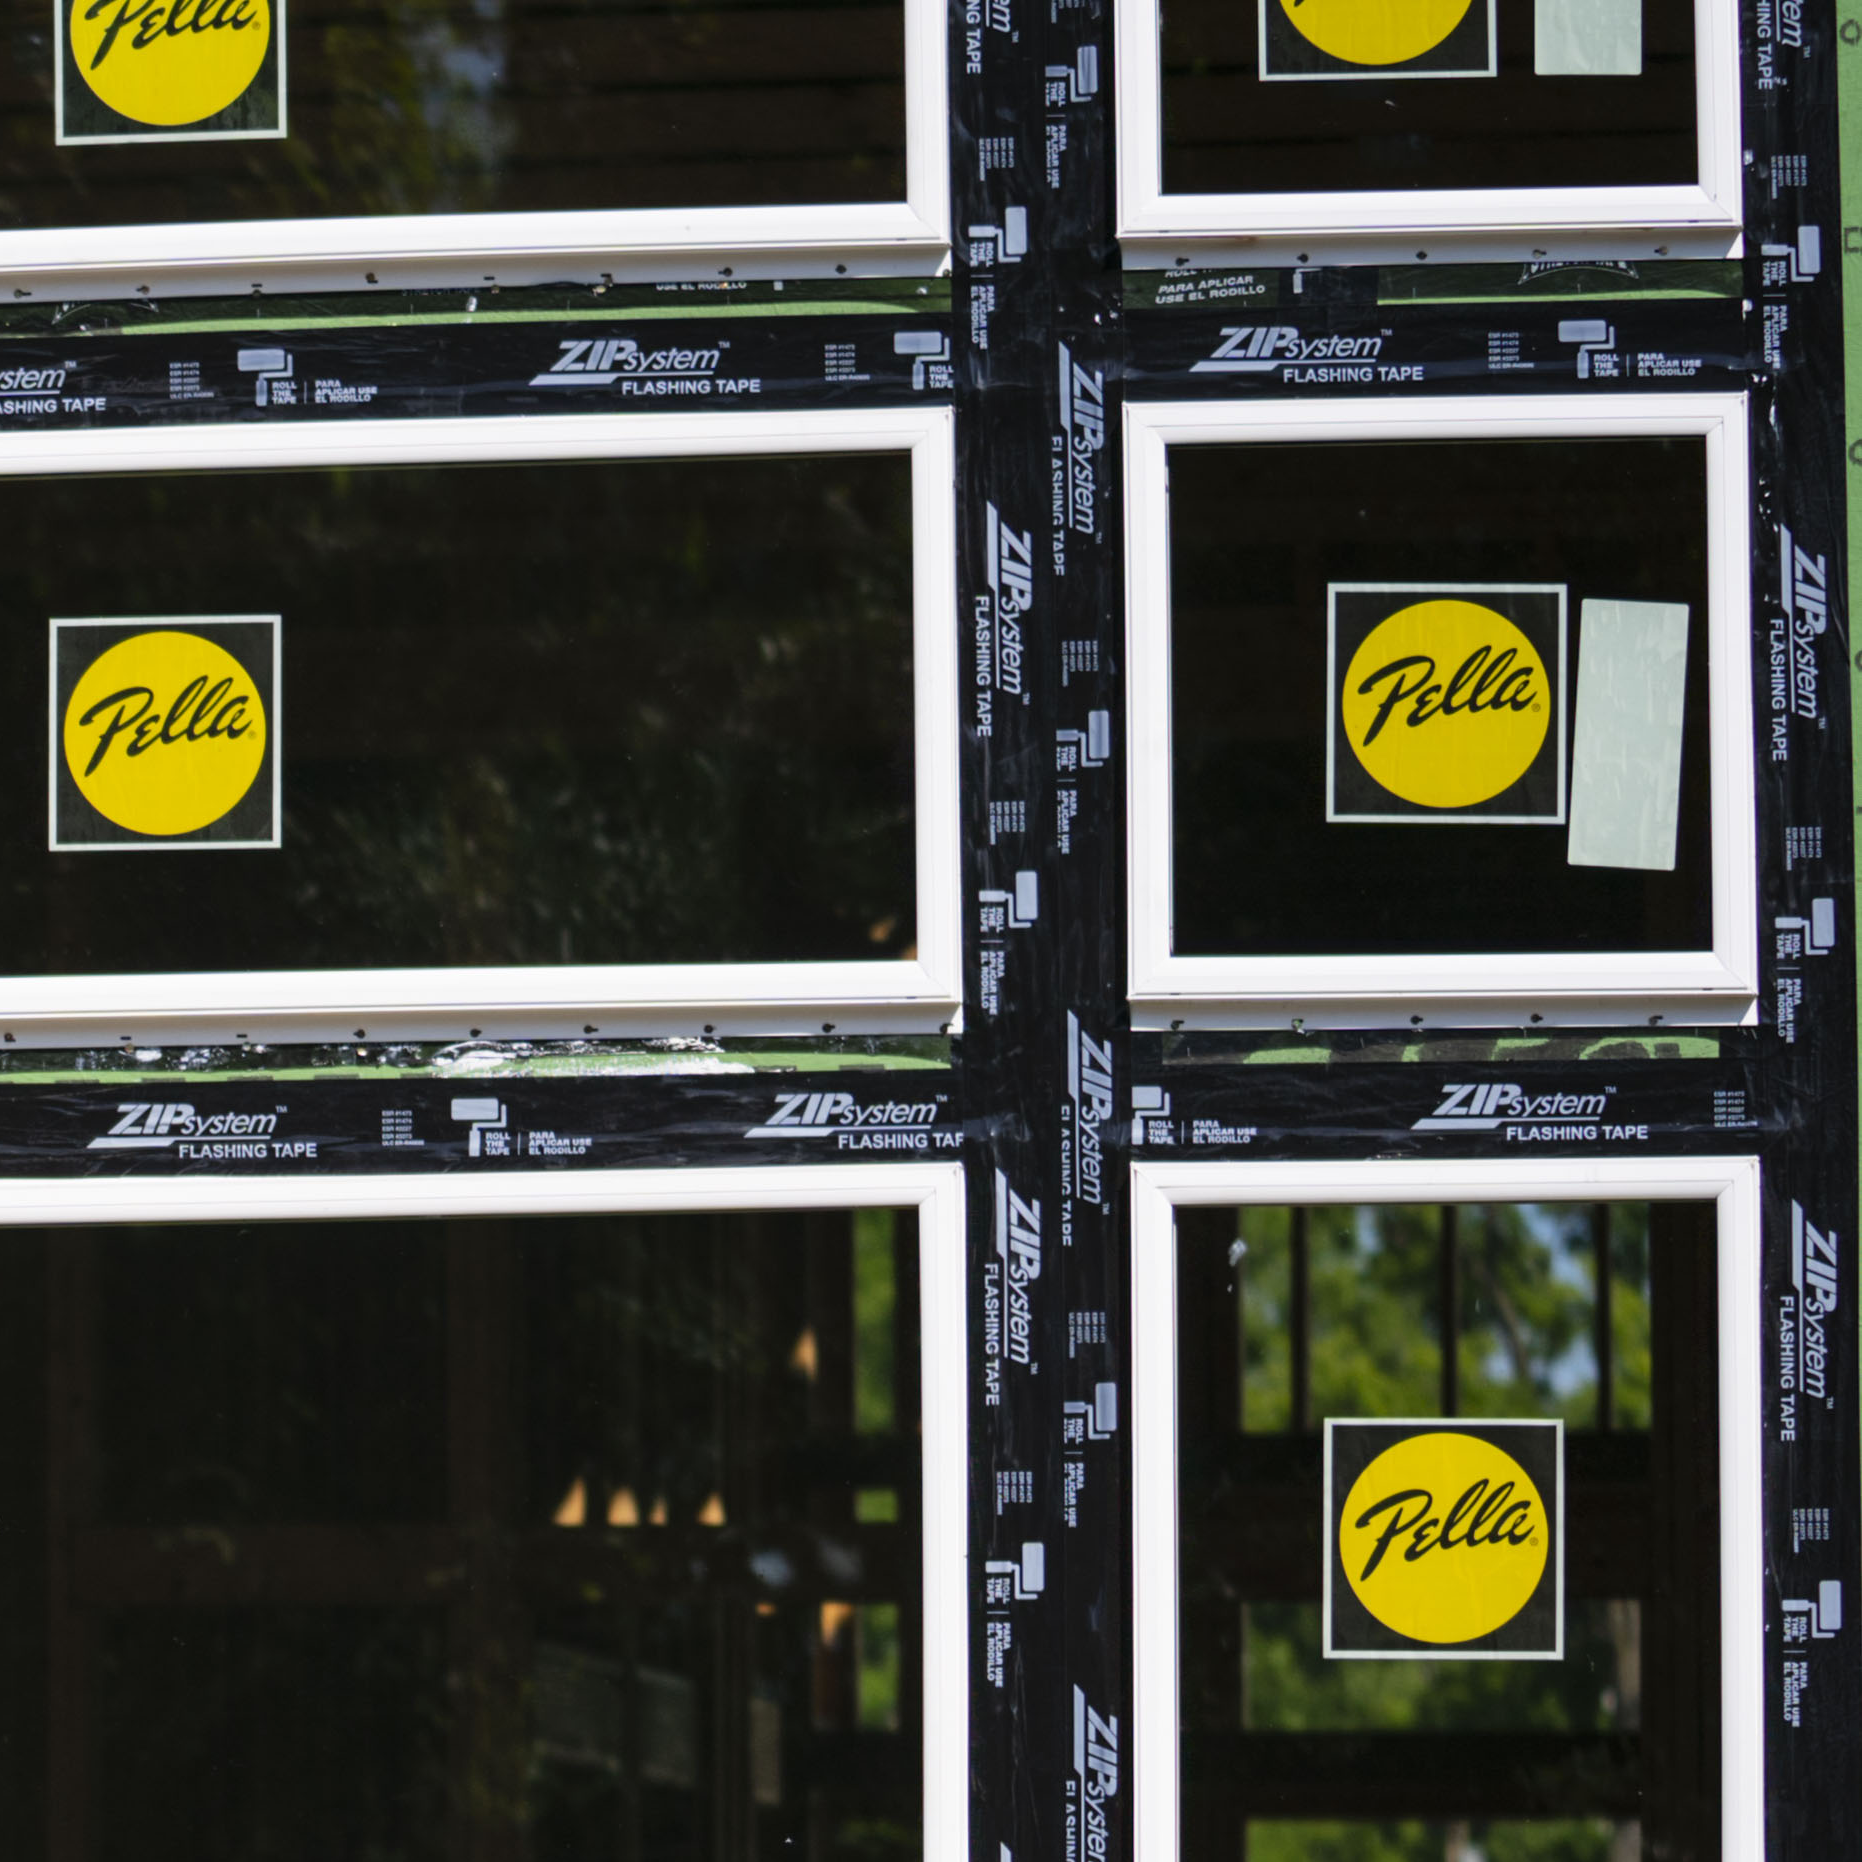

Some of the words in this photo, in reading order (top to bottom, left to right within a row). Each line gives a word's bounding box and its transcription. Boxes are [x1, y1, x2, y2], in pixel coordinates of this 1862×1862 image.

[1284, 367, 1372, 382] FLASHING
[1377, 366, 1423, 381] TAPE
[622, 380, 711, 395] FLASHING
[716, 379, 760, 393] TAPE
[62, 397, 106, 412] TAPE
[1357, 645, 1537, 747] Pella
[79, 675, 252, 777] Pella
[1507, 1126, 1597, 1140] FLASHING
[1602, 1125, 1648, 1139] TAPE
[839, 1133, 928, 1149] FLASHING
[179, 1144, 267, 1158] FLASHING
[272, 1142, 317, 1157] TAPE
[1780, 1296, 1794, 1388] FLASHING
[1781, 1394, 1795, 1441] TAPE
[1355, 1478, 1535, 1582] Pella
